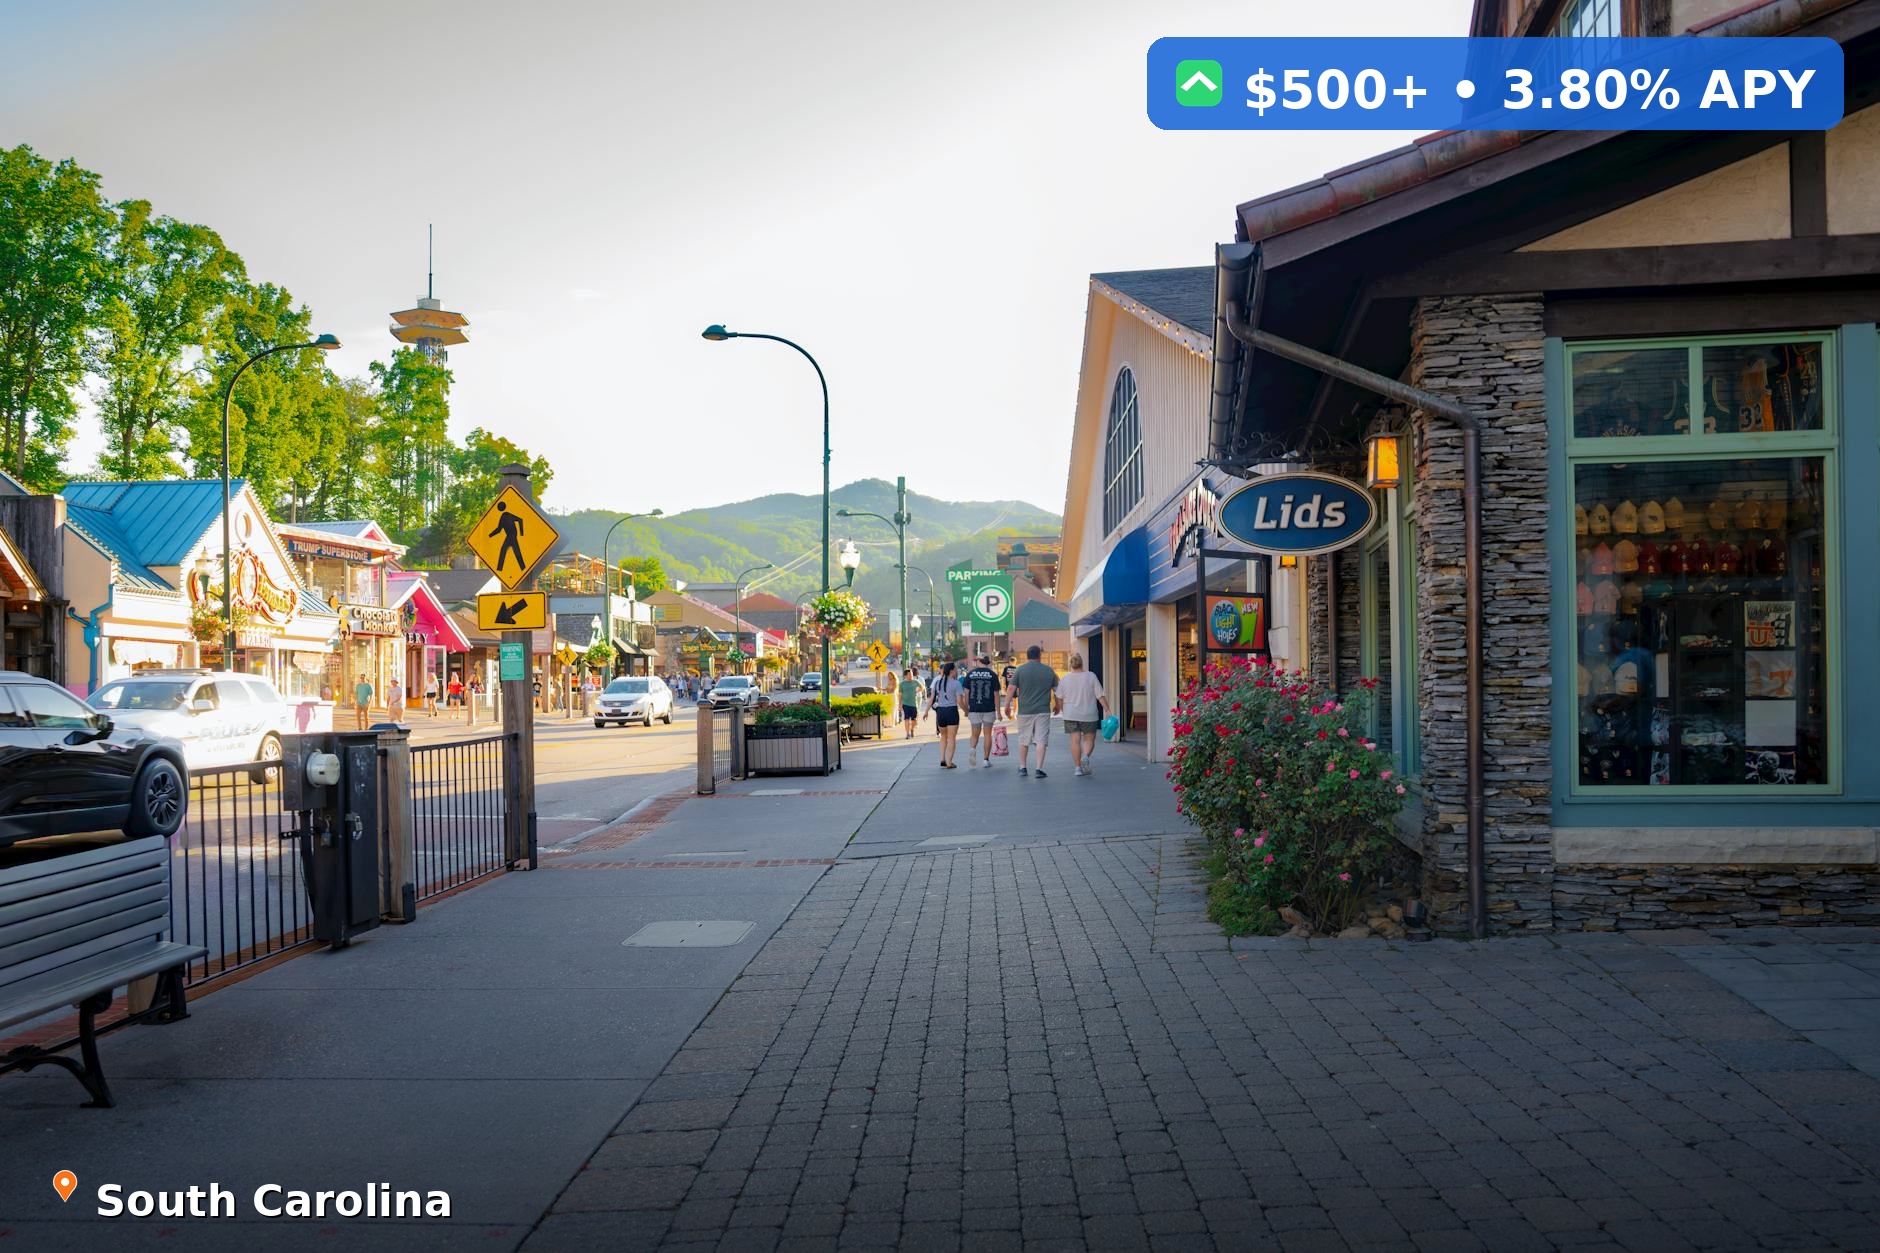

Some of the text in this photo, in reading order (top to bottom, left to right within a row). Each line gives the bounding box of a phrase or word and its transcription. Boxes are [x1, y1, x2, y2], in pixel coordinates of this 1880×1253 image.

[1254, 494, 1346, 529] Lids
[293, 541, 368, 561] TRUMP SUPERSTORE
[986, 595, 1000, 613] P
[1215, 603, 1235, 616] BLACK
[1241, 602, 1258, 614] NEW
[363, 620, 398, 634] Monkey
[1216, 614, 1236, 628] LIGHT
[1217, 628, 1238, 643] HOLES
